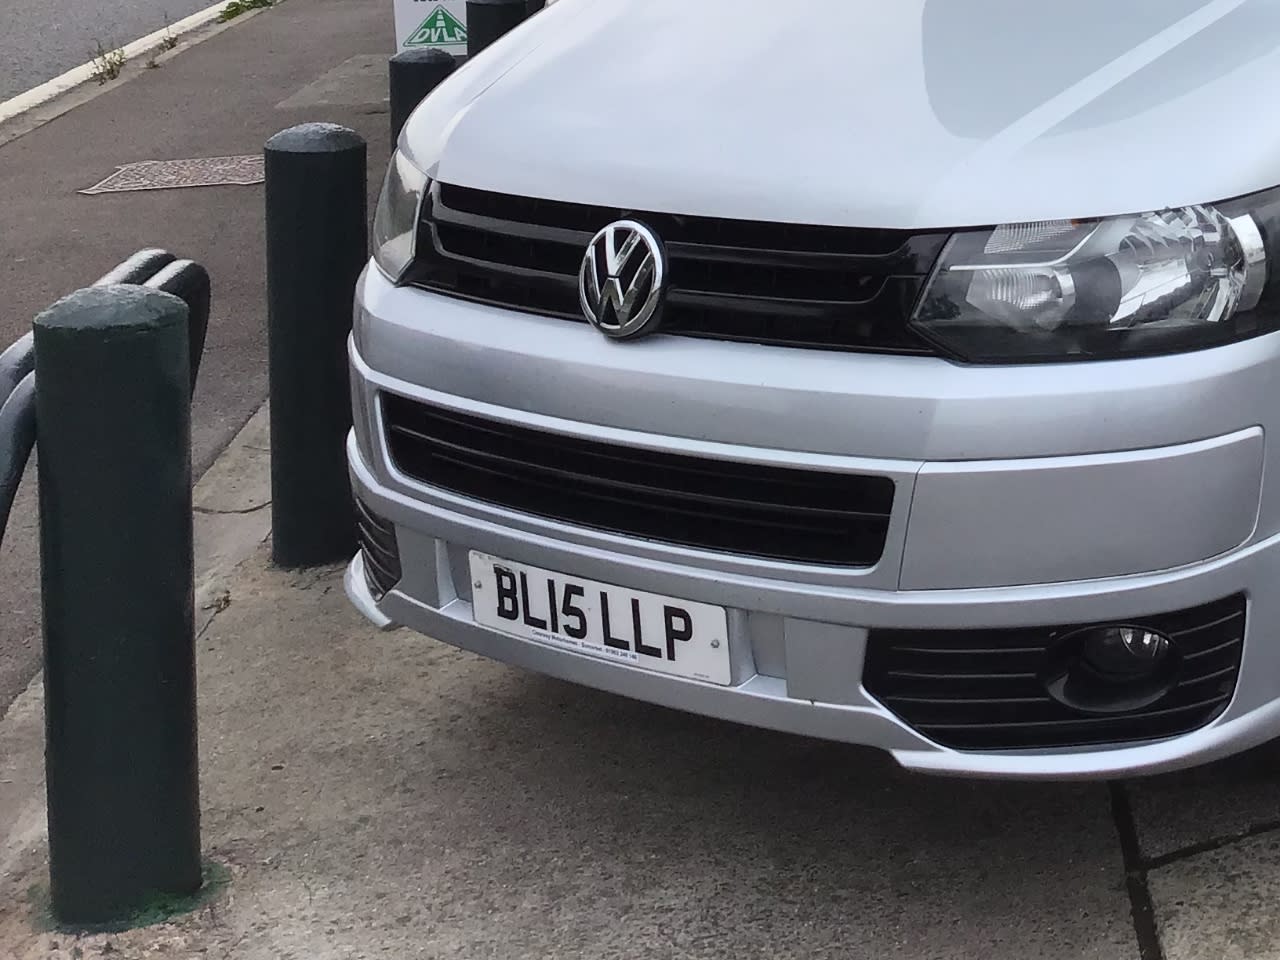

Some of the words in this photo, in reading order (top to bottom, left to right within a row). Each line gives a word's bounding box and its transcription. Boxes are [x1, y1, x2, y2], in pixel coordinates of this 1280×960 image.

[411, 27, 467, 42] DVLA
[494, 564, 588, 640] BL15
[600, 591, 692, 661] LLP
